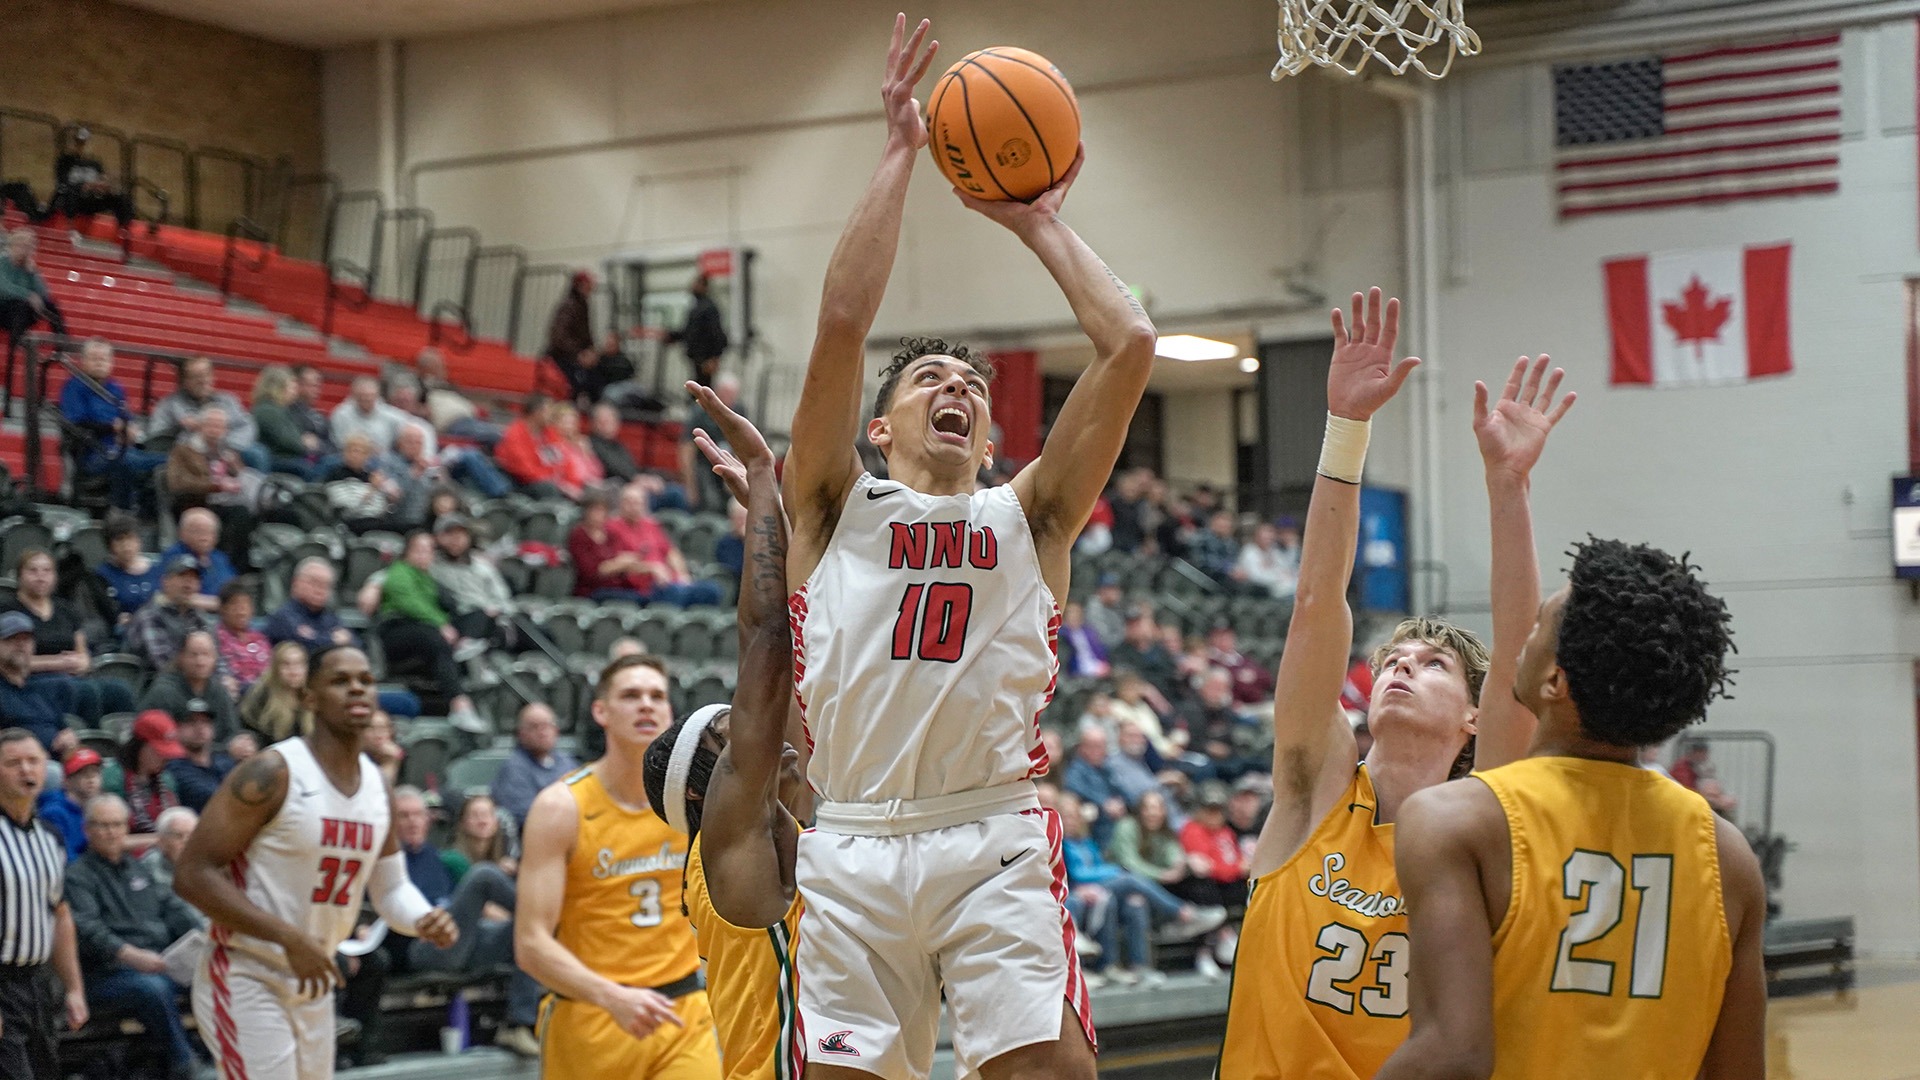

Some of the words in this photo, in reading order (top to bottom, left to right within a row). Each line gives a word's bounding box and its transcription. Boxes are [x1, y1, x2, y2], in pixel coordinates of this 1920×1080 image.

[888, 520, 998, 570] NNU
[890, 581, 974, 664] 10
[311, 856, 363, 906] 32
[629, 878, 663, 929] 3
[1549, 847, 1675, 1000] 21
[1304, 920, 1411, 1020] 23
